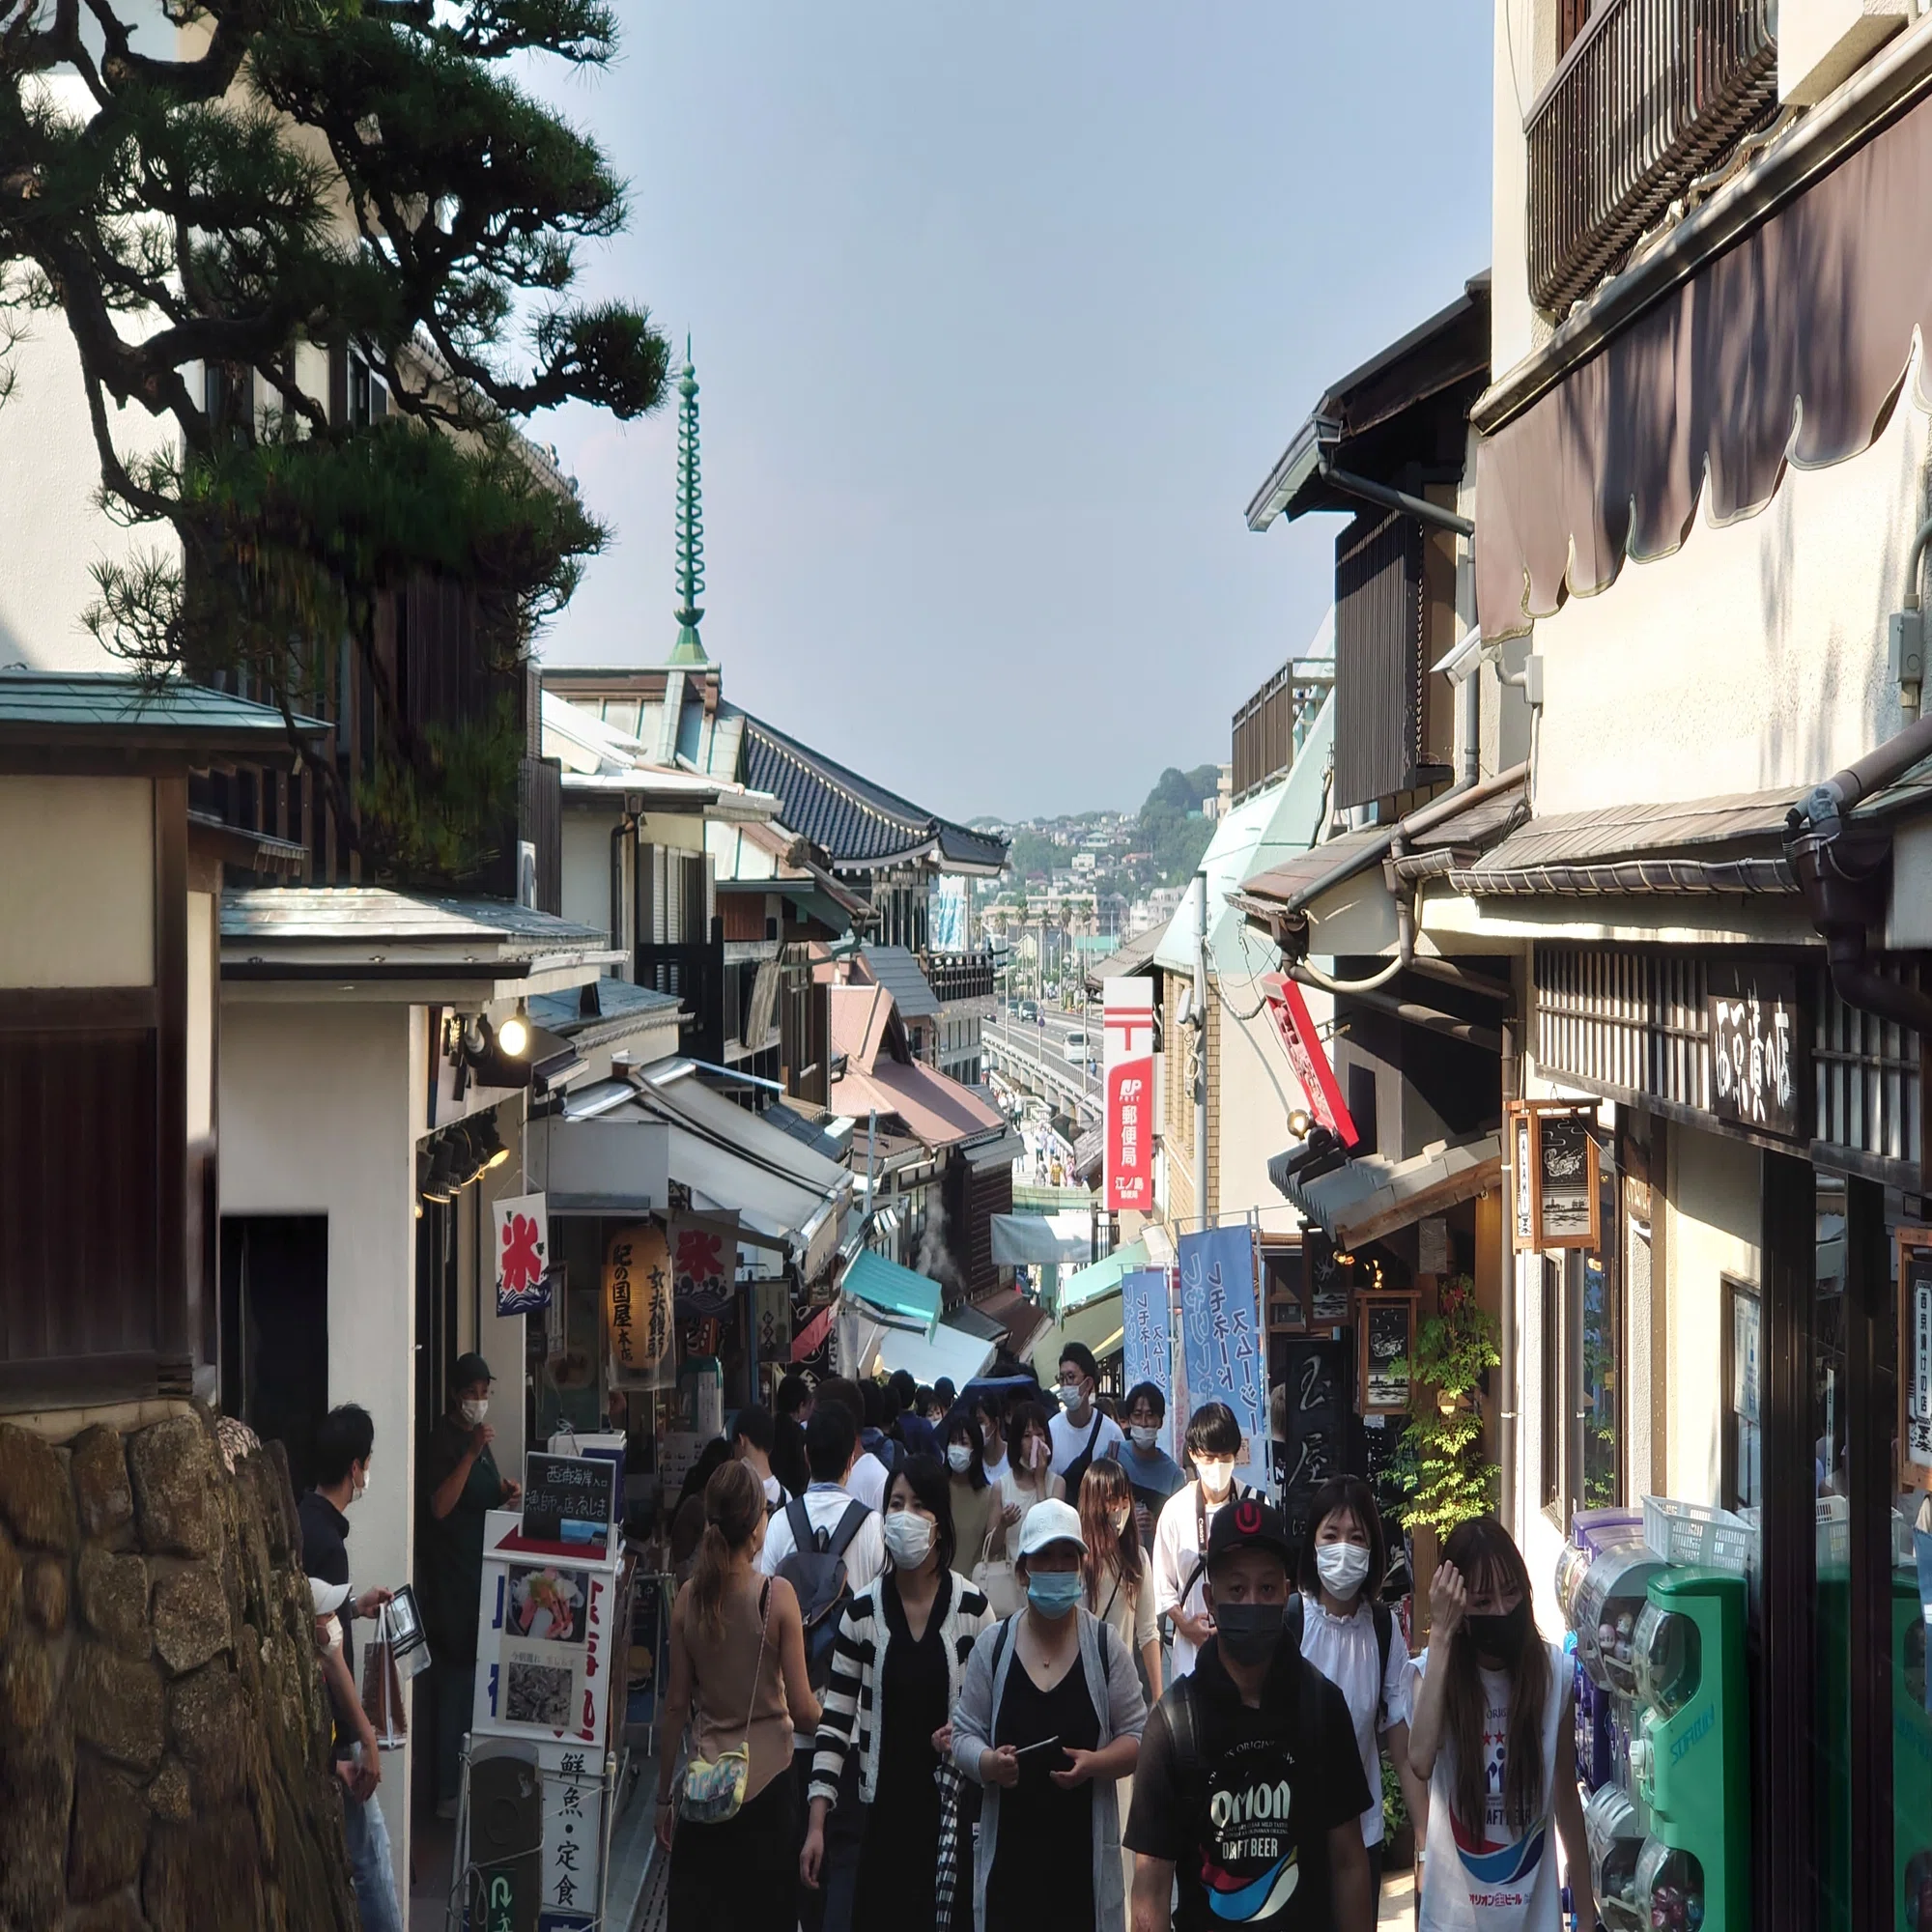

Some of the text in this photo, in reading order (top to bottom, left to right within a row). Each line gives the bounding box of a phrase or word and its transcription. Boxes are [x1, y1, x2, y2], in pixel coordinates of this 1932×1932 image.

[1122, 1105, 1137, 1167] 郵便局
[1115, 1177, 1144, 1190] 江ノ島
[501, 1213, 542, 1293] 氷
[1250, 1837, 1278, 1858] BEER
[1469, 1892, 1522, 1907] オリオン生ビール
